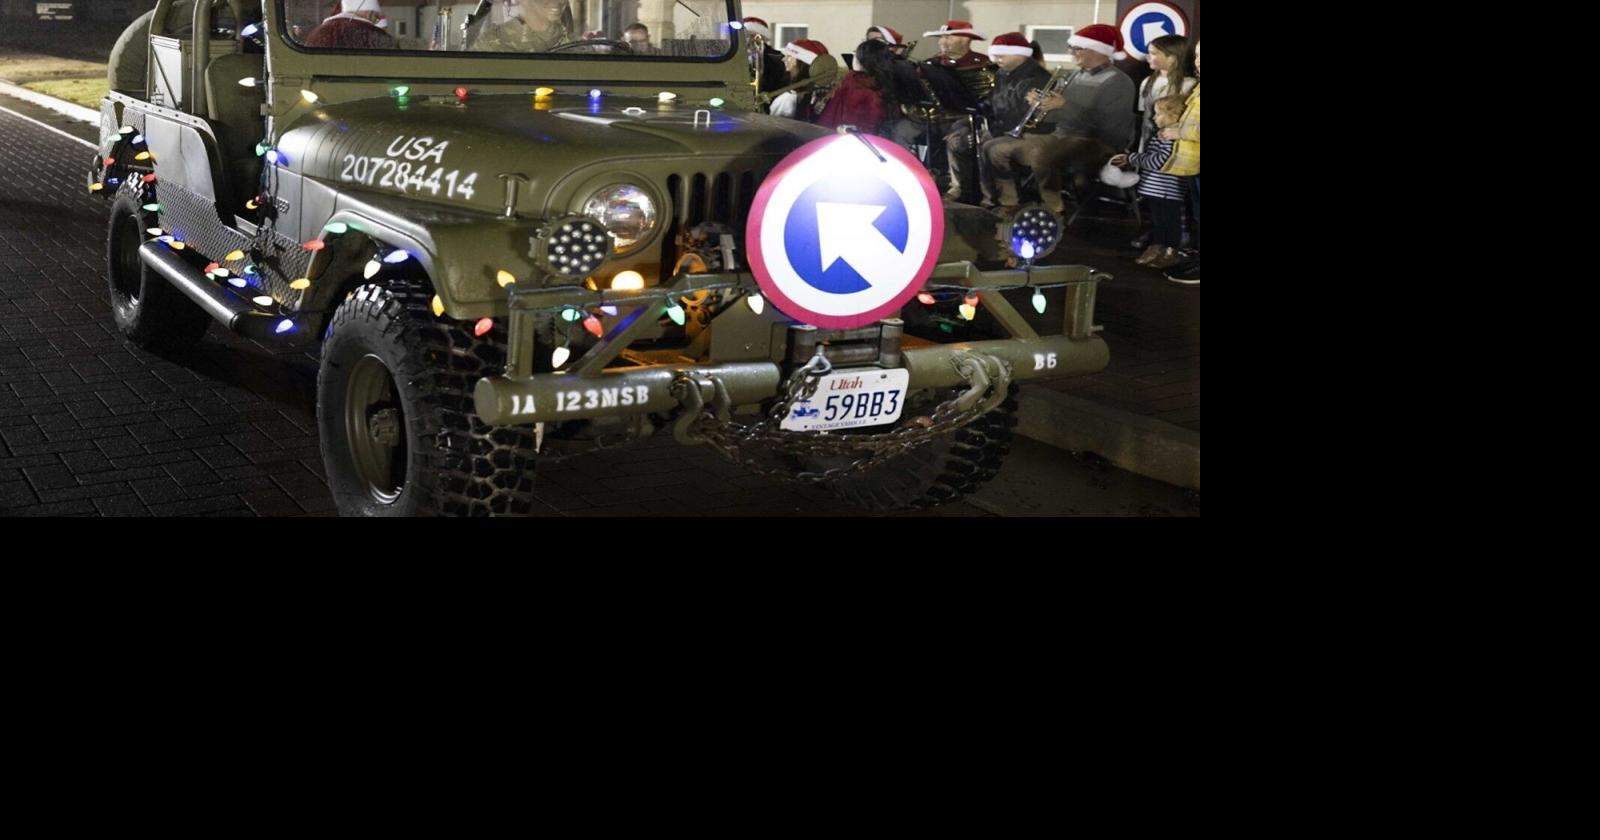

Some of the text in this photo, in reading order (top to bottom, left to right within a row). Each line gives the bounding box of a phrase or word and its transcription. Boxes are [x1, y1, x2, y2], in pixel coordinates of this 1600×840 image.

[386, 135, 449, 164] USA
[340, 154, 478, 200] 207284414
[1033, 352, 1057, 371] B6
[830, 376, 864, 391] Utah
[556, 385, 649, 412] 123MSB
[825, 390, 901, 421] 59BB3
